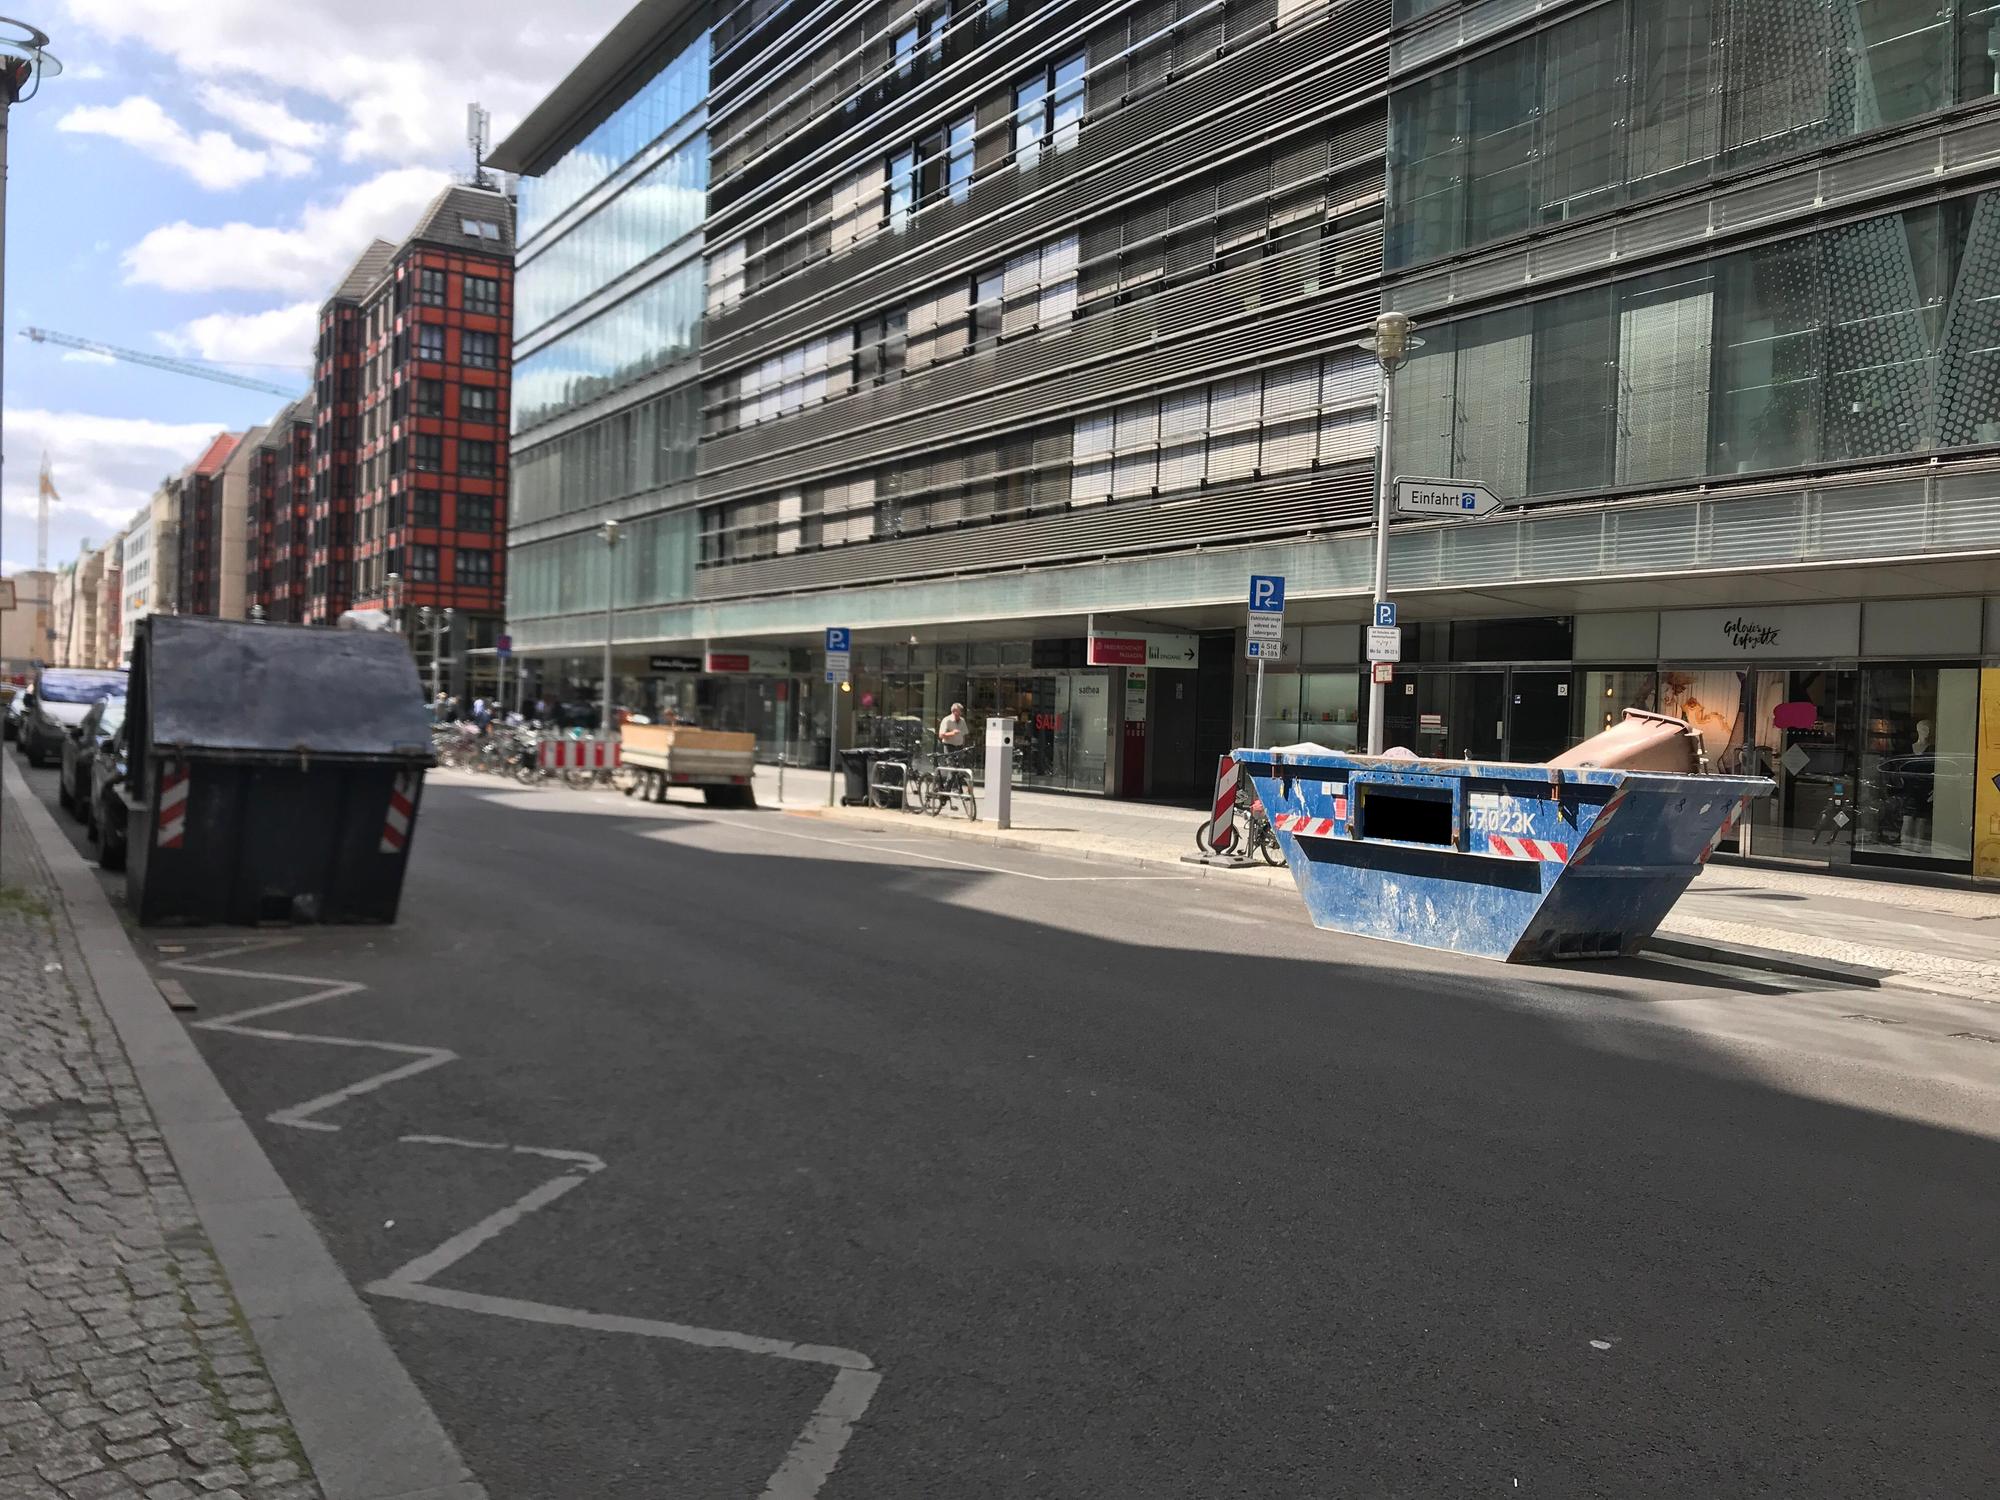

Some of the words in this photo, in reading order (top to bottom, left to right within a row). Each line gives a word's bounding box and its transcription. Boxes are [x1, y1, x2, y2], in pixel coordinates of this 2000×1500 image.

[1411, 491, 1460, 507] Einfahrt
[1255, 580, 1275, 607] P
[1380, 605, 1391, 624] P
[1724, 617, 1761, 637] Galeries
[830, 630, 843, 649] P
[1733, 627, 1781, 649] Lafayette
